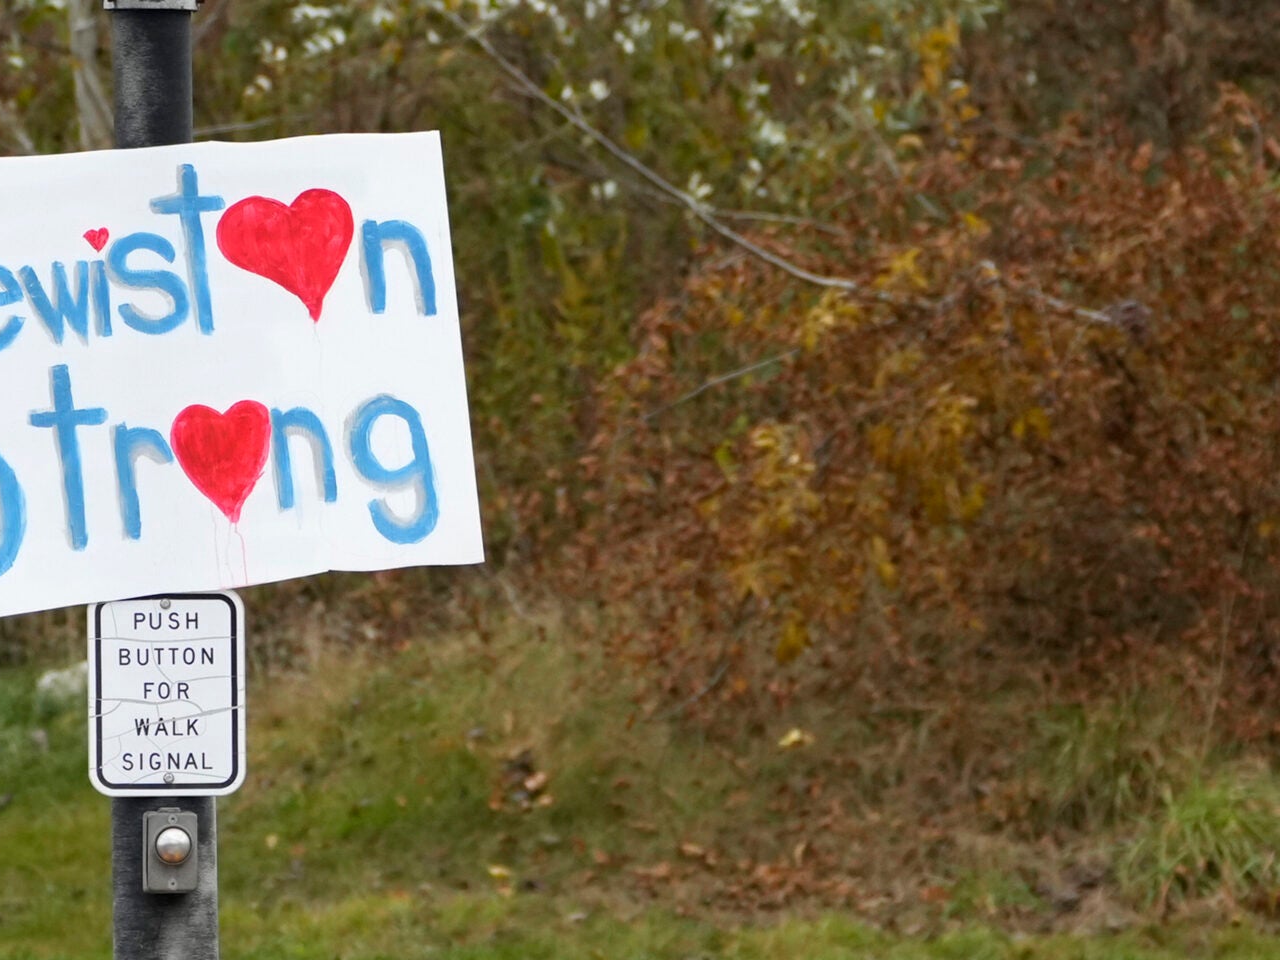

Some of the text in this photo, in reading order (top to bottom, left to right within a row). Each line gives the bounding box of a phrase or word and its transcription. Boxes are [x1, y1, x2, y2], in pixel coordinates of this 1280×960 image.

[133, 612, 199, 630] PUSH
[119, 647, 215, 666] BUTTON
[143, 682, 190, 700] FOR
[134, 718, 200, 736] WALK
[122, 752, 213, 770] SIGNAL
